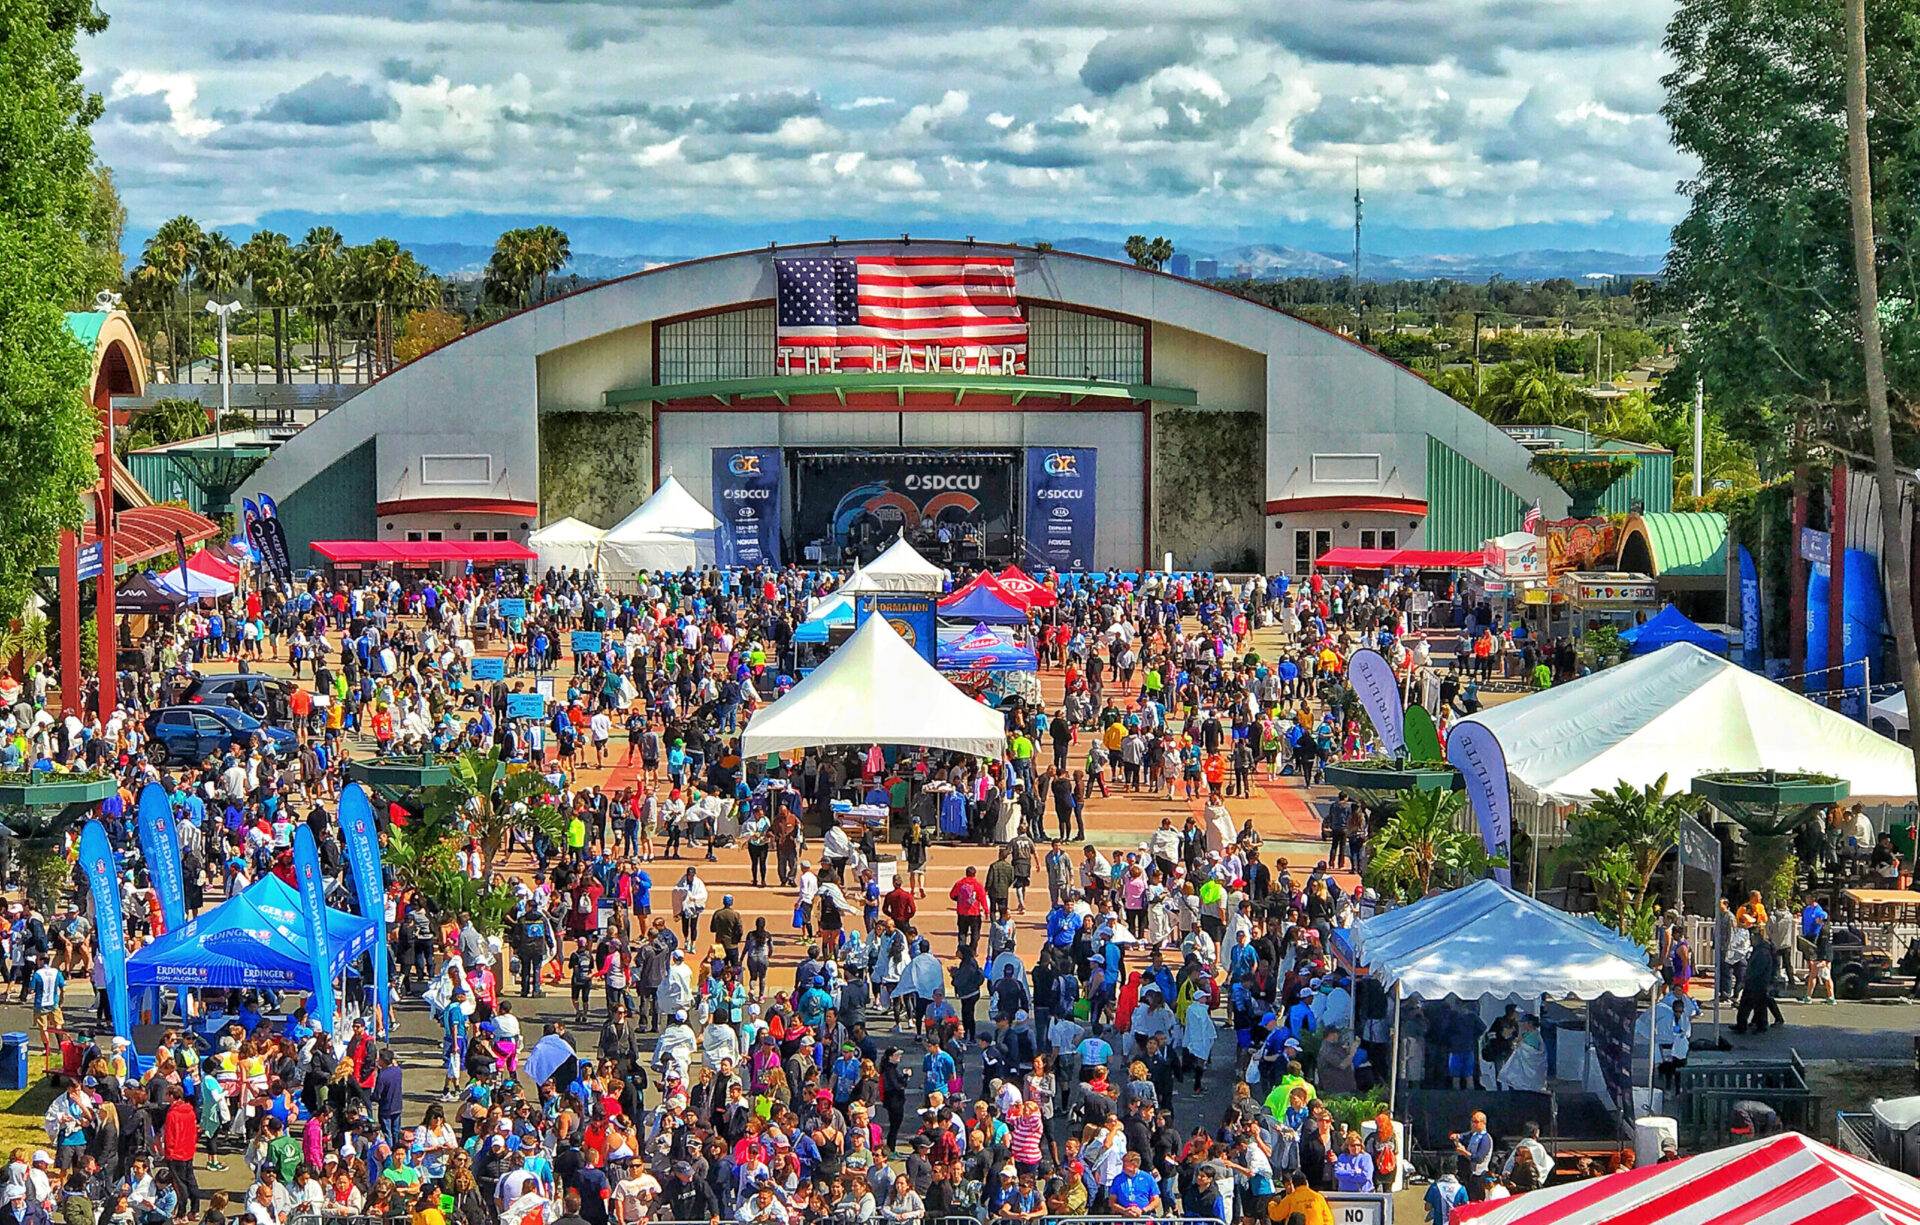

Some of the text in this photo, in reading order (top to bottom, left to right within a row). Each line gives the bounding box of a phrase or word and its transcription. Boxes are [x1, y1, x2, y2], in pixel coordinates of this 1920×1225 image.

[779, 345, 1017, 376] THE HANGAR
[922, 475, 981, 490] SDCCU
[734, 489, 769, 499] SDCCU
[1047, 489, 1083, 499] SDCCU
[1582, 587, 1602, 598] HOT
[1605, 587, 1628, 598] DOG
[1636, 588, 1654, 598] STICK
[1361, 662, 1399, 744] NUTRILITE
[1460, 736, 1504, 837] NUTRILITE
[199, 928, 258, 944] ERDINGER
[156, 966, 198, 976] ERDINGER
[244, 968, 285, 978] ERDINGER
[1345, 1208, 1364, 1222] NO
